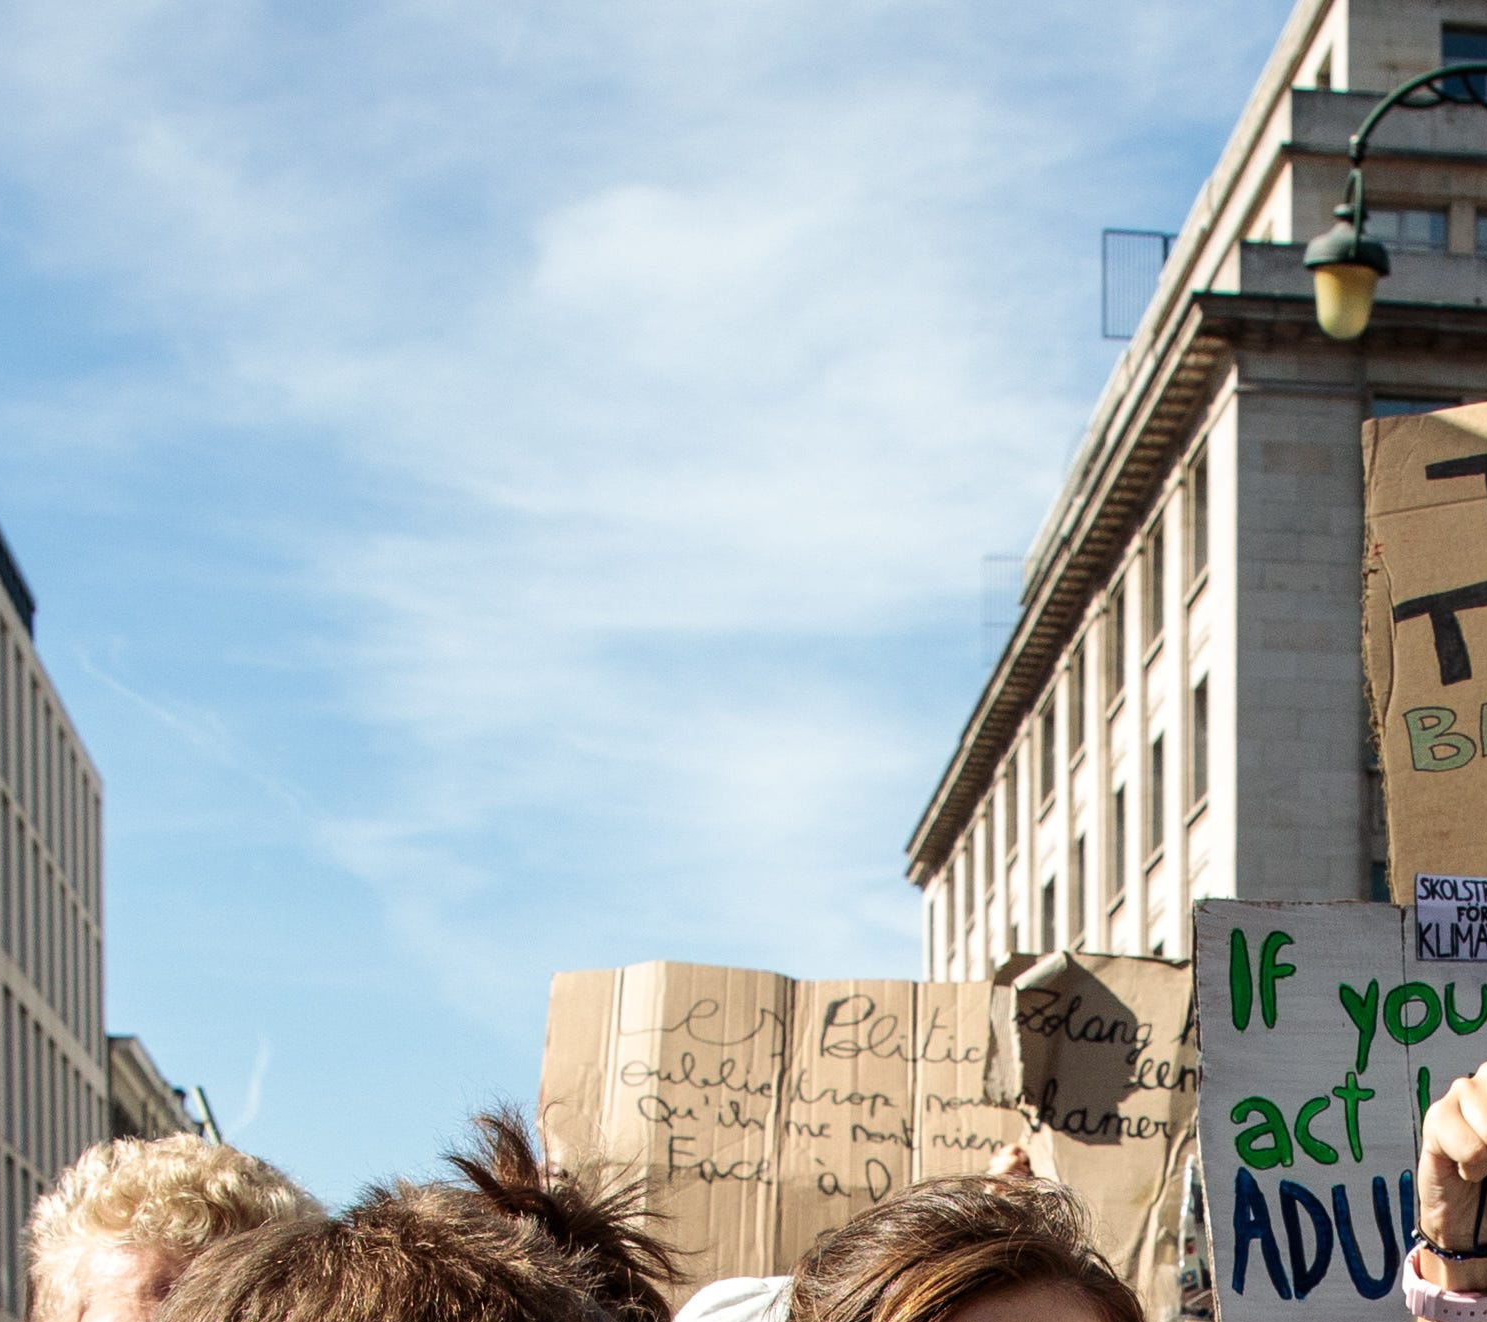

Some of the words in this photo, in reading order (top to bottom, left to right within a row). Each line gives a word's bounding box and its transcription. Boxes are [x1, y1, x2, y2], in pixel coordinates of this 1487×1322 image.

[819, 993, 986, 1063] Politic
[1230, 928, 1297, 1033] If
[1230, 1071, 1375, 1170] act
